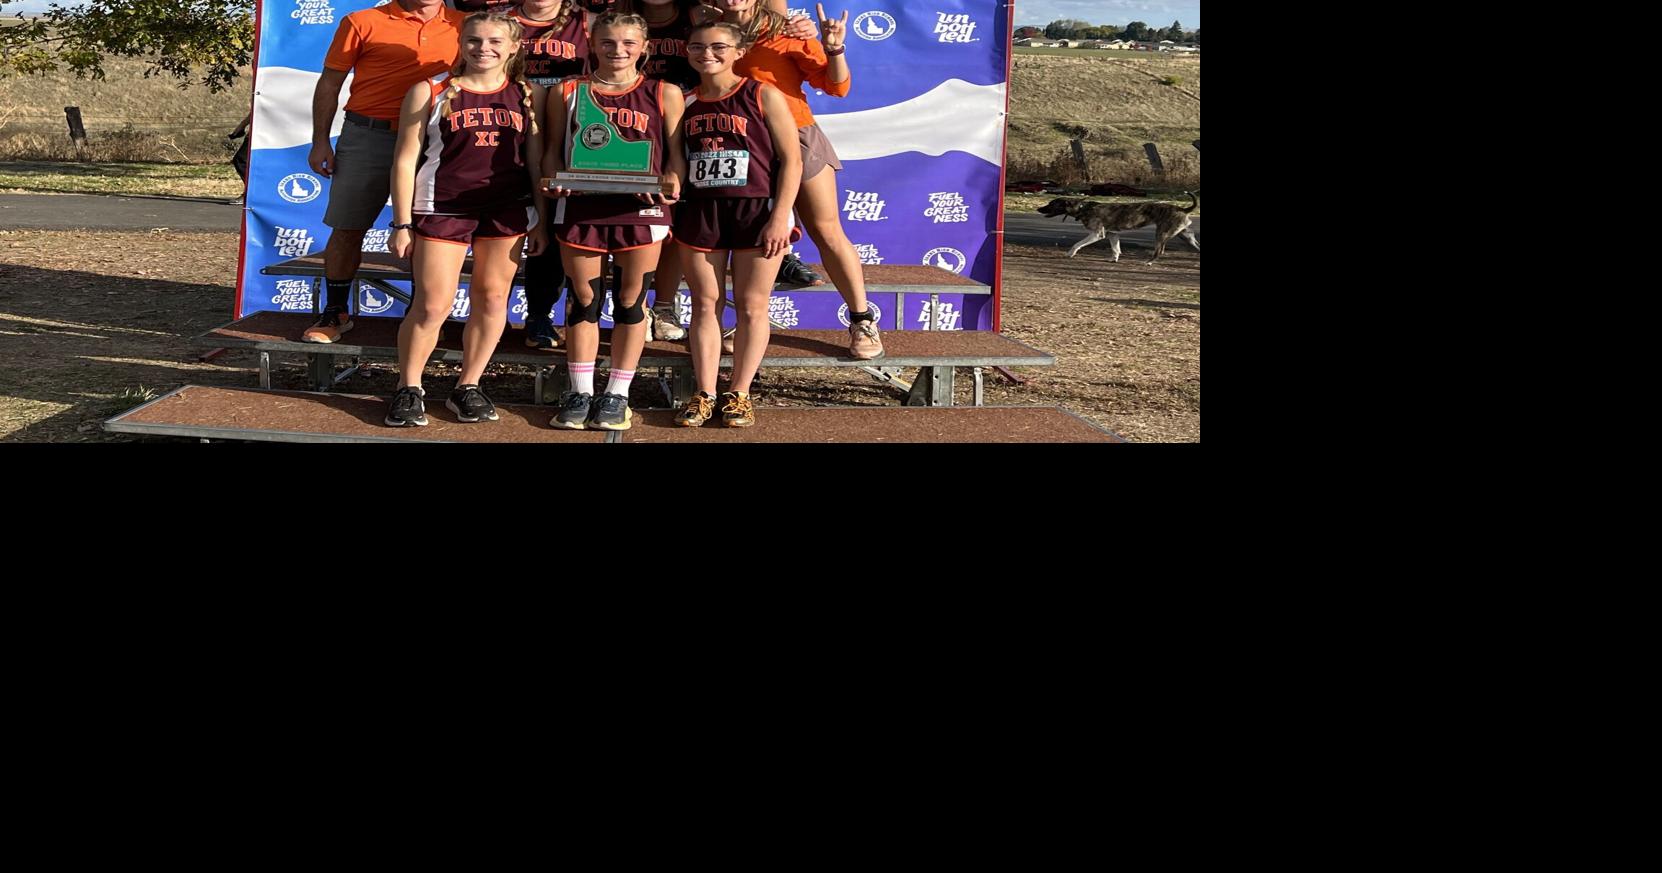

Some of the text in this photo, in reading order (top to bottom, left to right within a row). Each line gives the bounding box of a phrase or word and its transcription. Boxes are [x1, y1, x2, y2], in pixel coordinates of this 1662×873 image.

[299, 2, 329, 10] YOUR
[290, 7, 335, 19] GREAT
[935, 12, 969, 23] un
[300, 16, 334, 25] NESS
[447, 107, 524, 133] TETON
[603, 107, 650, 133] TON
[475, 131, 501, 146] XC
[701, 137, 725, 151] XC
[695, 158, 737, 180] 843
[845, 189, 878, 201] un
[928, 192, 963, 202] FUEL
[932, 199, 964, 208] YOUR
[924, 205, 969, 217] GREAT
[933, 213, 968, 223] NESS
[276, 279, 309, 289] FUEL
[279, 286, 310, 296] YOUR
[271, 293, 313, 304] GREAT
[280, 301, 313, 311] NESS
